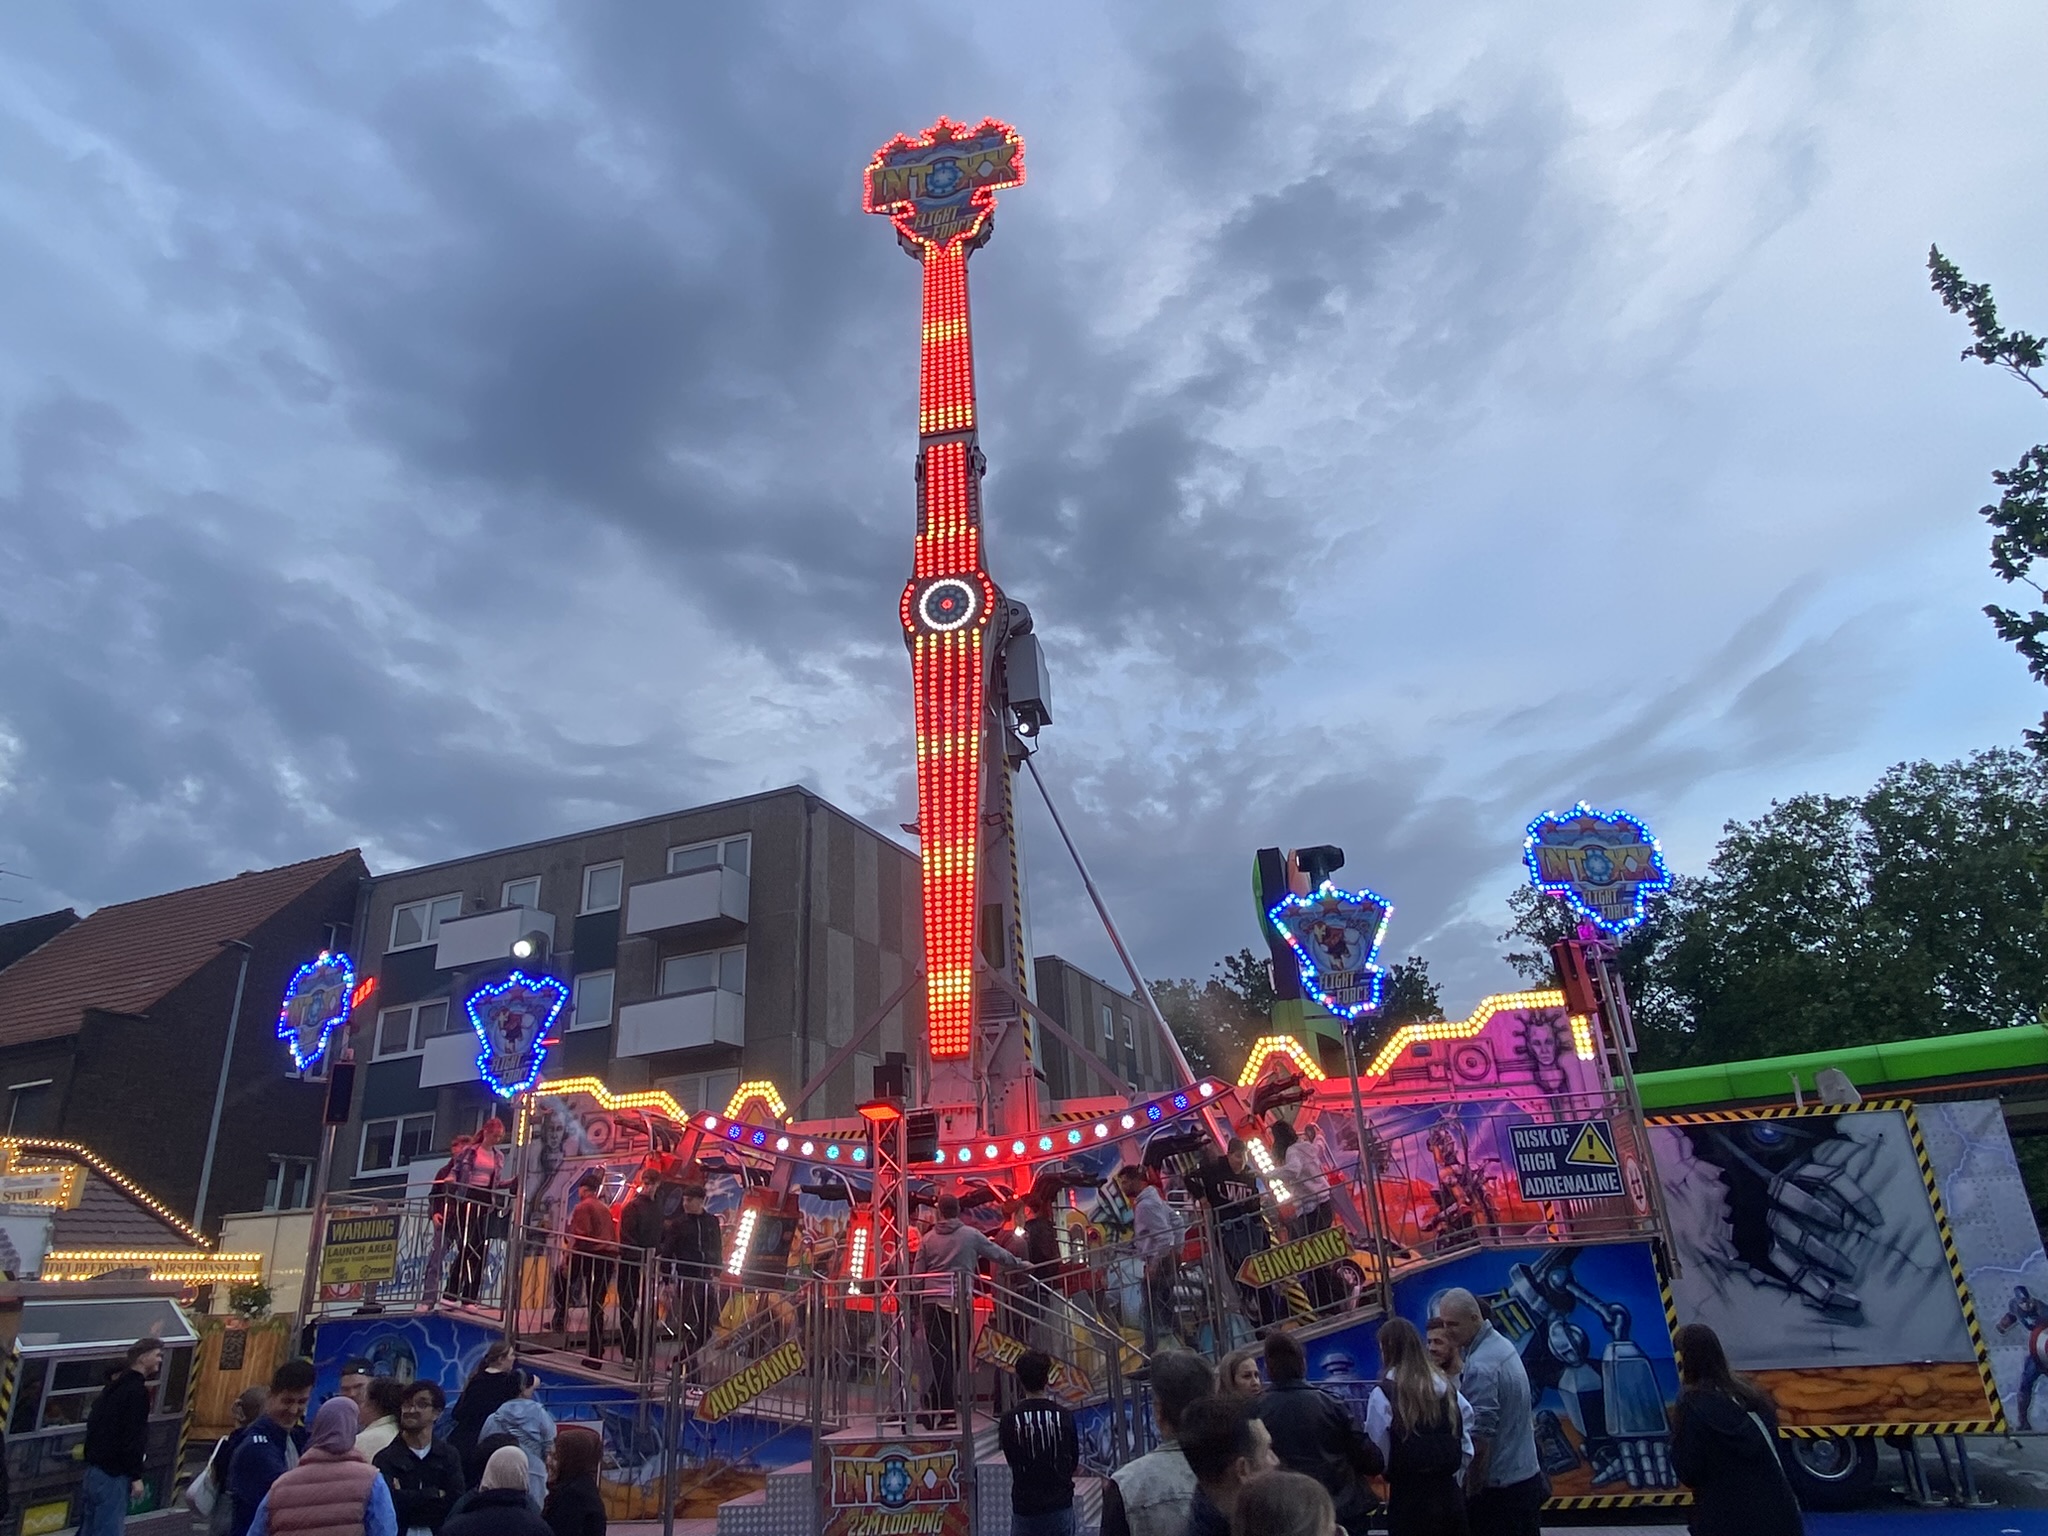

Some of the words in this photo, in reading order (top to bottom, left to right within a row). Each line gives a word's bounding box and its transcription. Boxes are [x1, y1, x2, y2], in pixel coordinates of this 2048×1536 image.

[913, 206, 960, 230] FLIGHT
[1582, 889, 1618, 905] FLIGHT
[1319, 972, 1355, 991] FLIGHT
[1335, 986, 1370, 1004] FORCE
[492, 1054, 523, 1071] FLIGHT
[1514, 1128, 1551, 1149] RISK
[1550, 1127, 1570, 1147] OF
[1519, 1152, 1557, 1172] HIGH
[1525, 1172, 1619, 1196] ADRENALINE
[3, 1188, 43, 1202] STUBE
[332, 1219, 395, 1242] WARNING
[328, 1246, 365, 1258] LAUNCH
[368, 1243, 393, 1253] AREA
[1253, 1229, 1347, 1283] EINGANG
[156, 1261, 241, 1273] KIRSCHWASSER
[709, 1342, 802, 1419] AUSGANG
[848, 1514, 881, 1535] 22M
[880, 1511, 944, 1535] LOOPING
